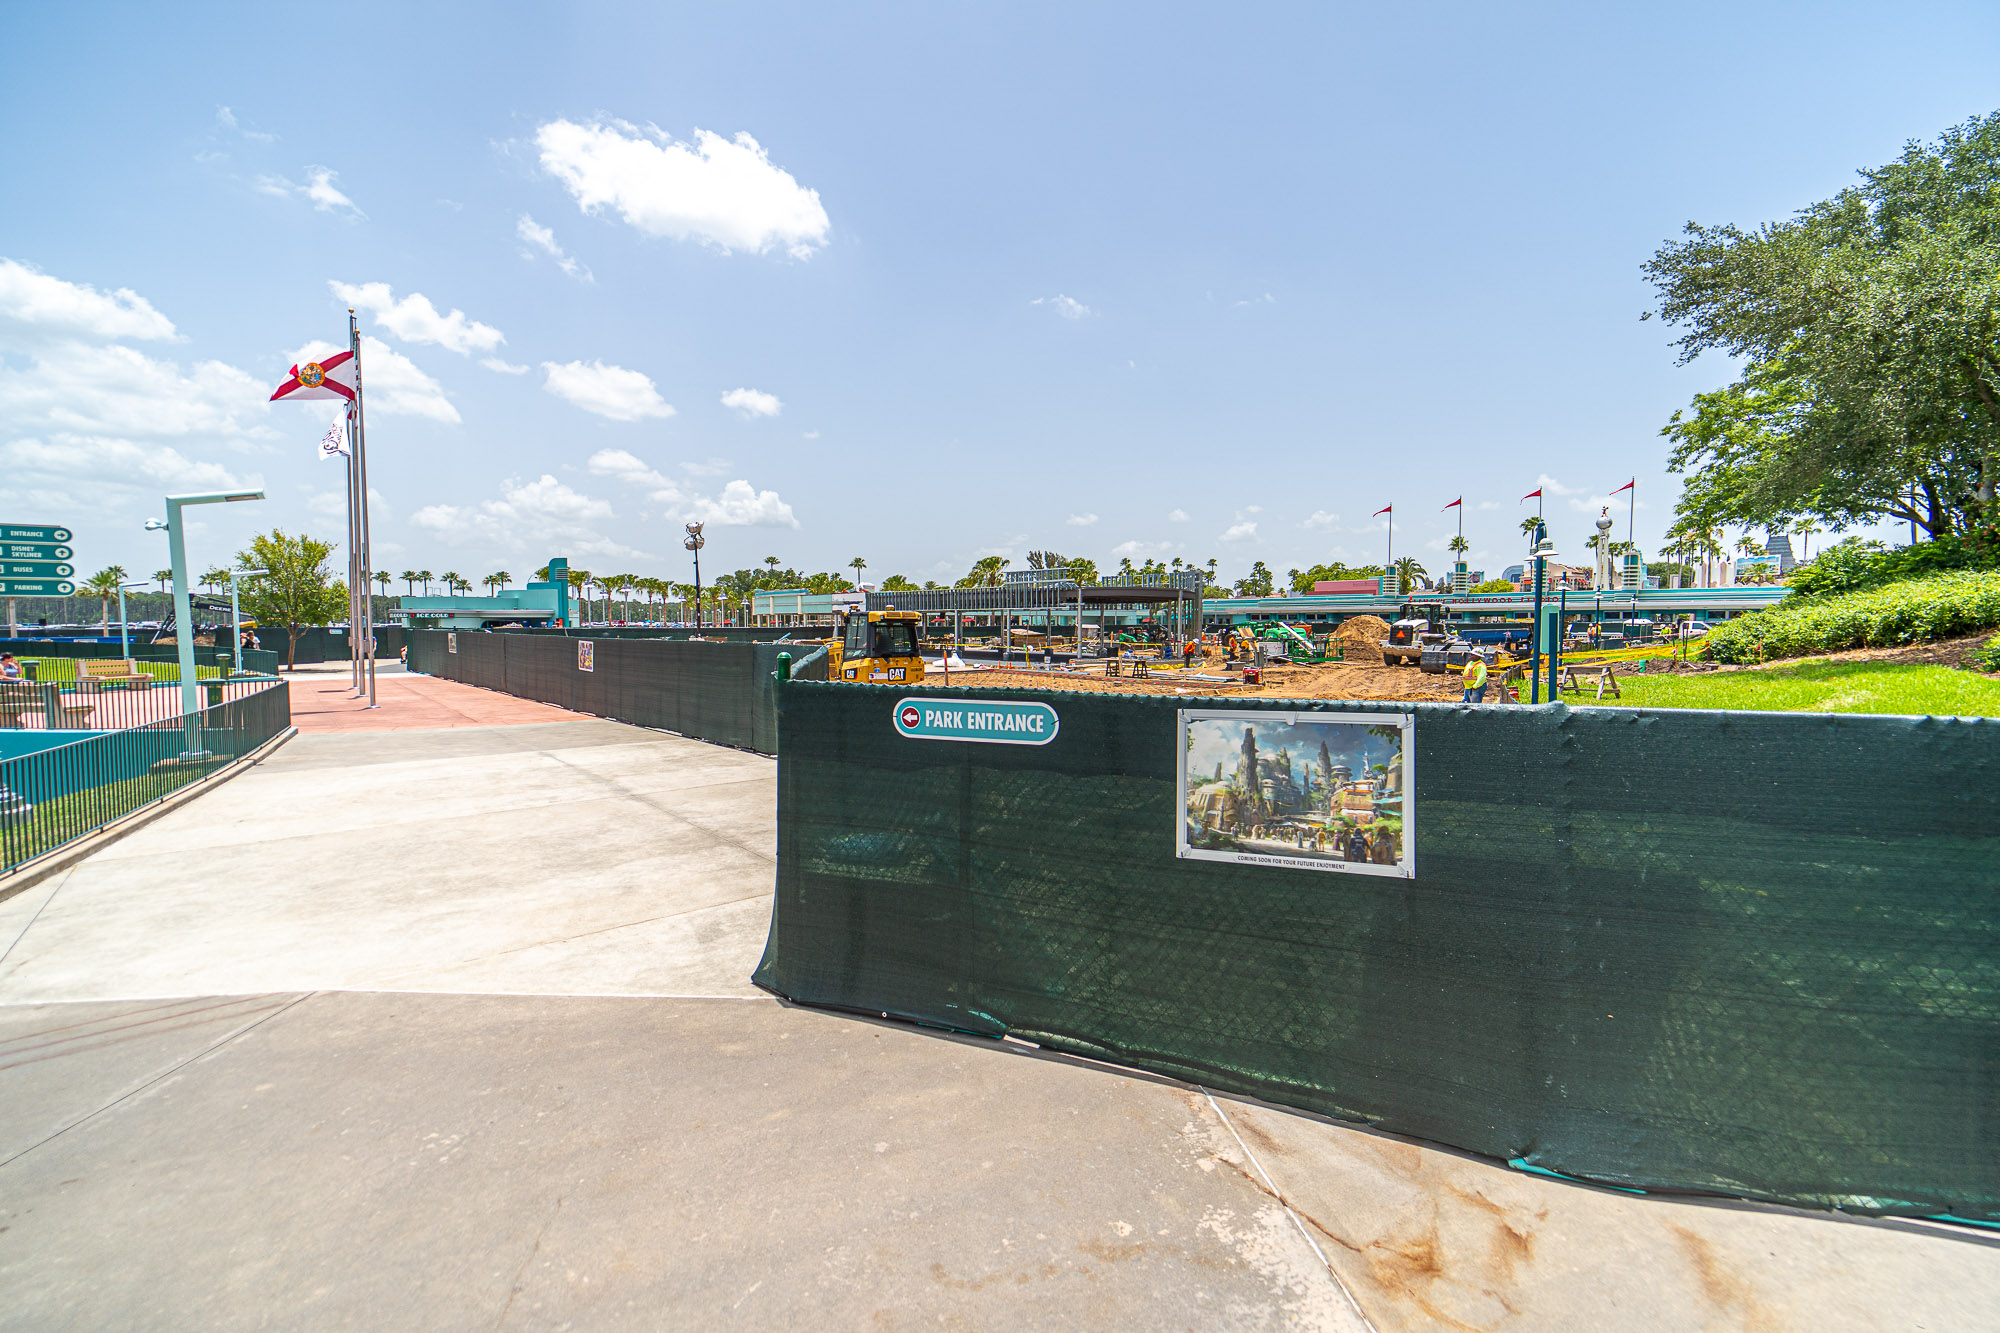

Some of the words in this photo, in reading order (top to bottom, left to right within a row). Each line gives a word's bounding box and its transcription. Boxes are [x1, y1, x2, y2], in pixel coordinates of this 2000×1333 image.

[10, 530, 44, 538] ENTRANCE
[1452, 597, 1513, 605] HOLLYWOOD
[846, 669, 855, 679] CAT
[889, 668, 905, 681] CAT
[925, 710, 963, 728] PARK
[967, 712, 1044, 733] ENTRANCE
[1316, 862, 1345, 870] ENJOYMENT
